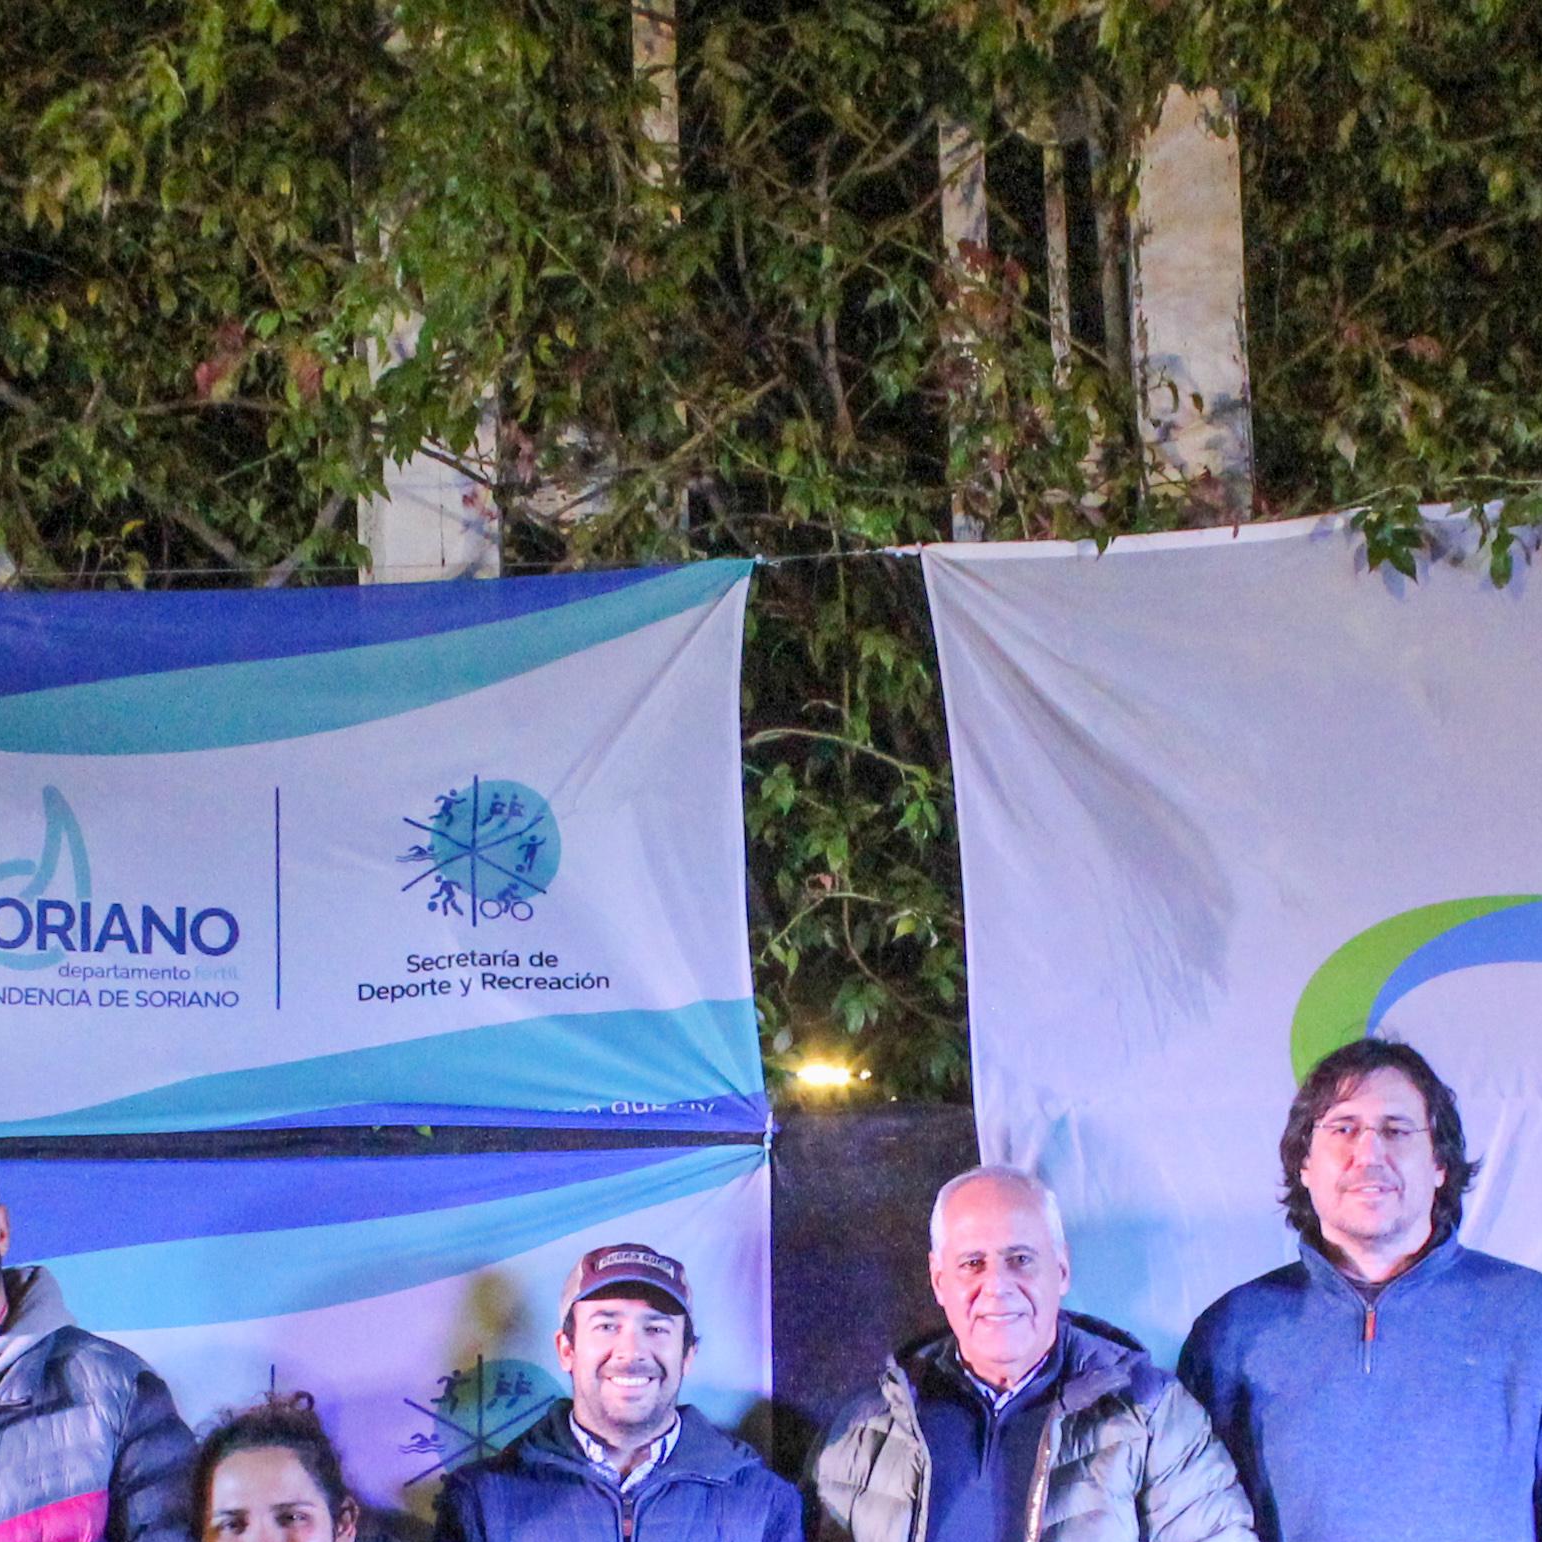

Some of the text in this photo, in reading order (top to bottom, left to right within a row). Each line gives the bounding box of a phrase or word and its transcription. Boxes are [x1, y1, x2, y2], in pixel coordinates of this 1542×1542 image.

[406, 949, 558, 973] Secretaría de
[58, 962, 191, 983] departamento
[357, 972, 610, 1003] Deporte y Recreación
[98, 989, 129, 1008] DE
[135, 990, 240, 1009] SORIANO
